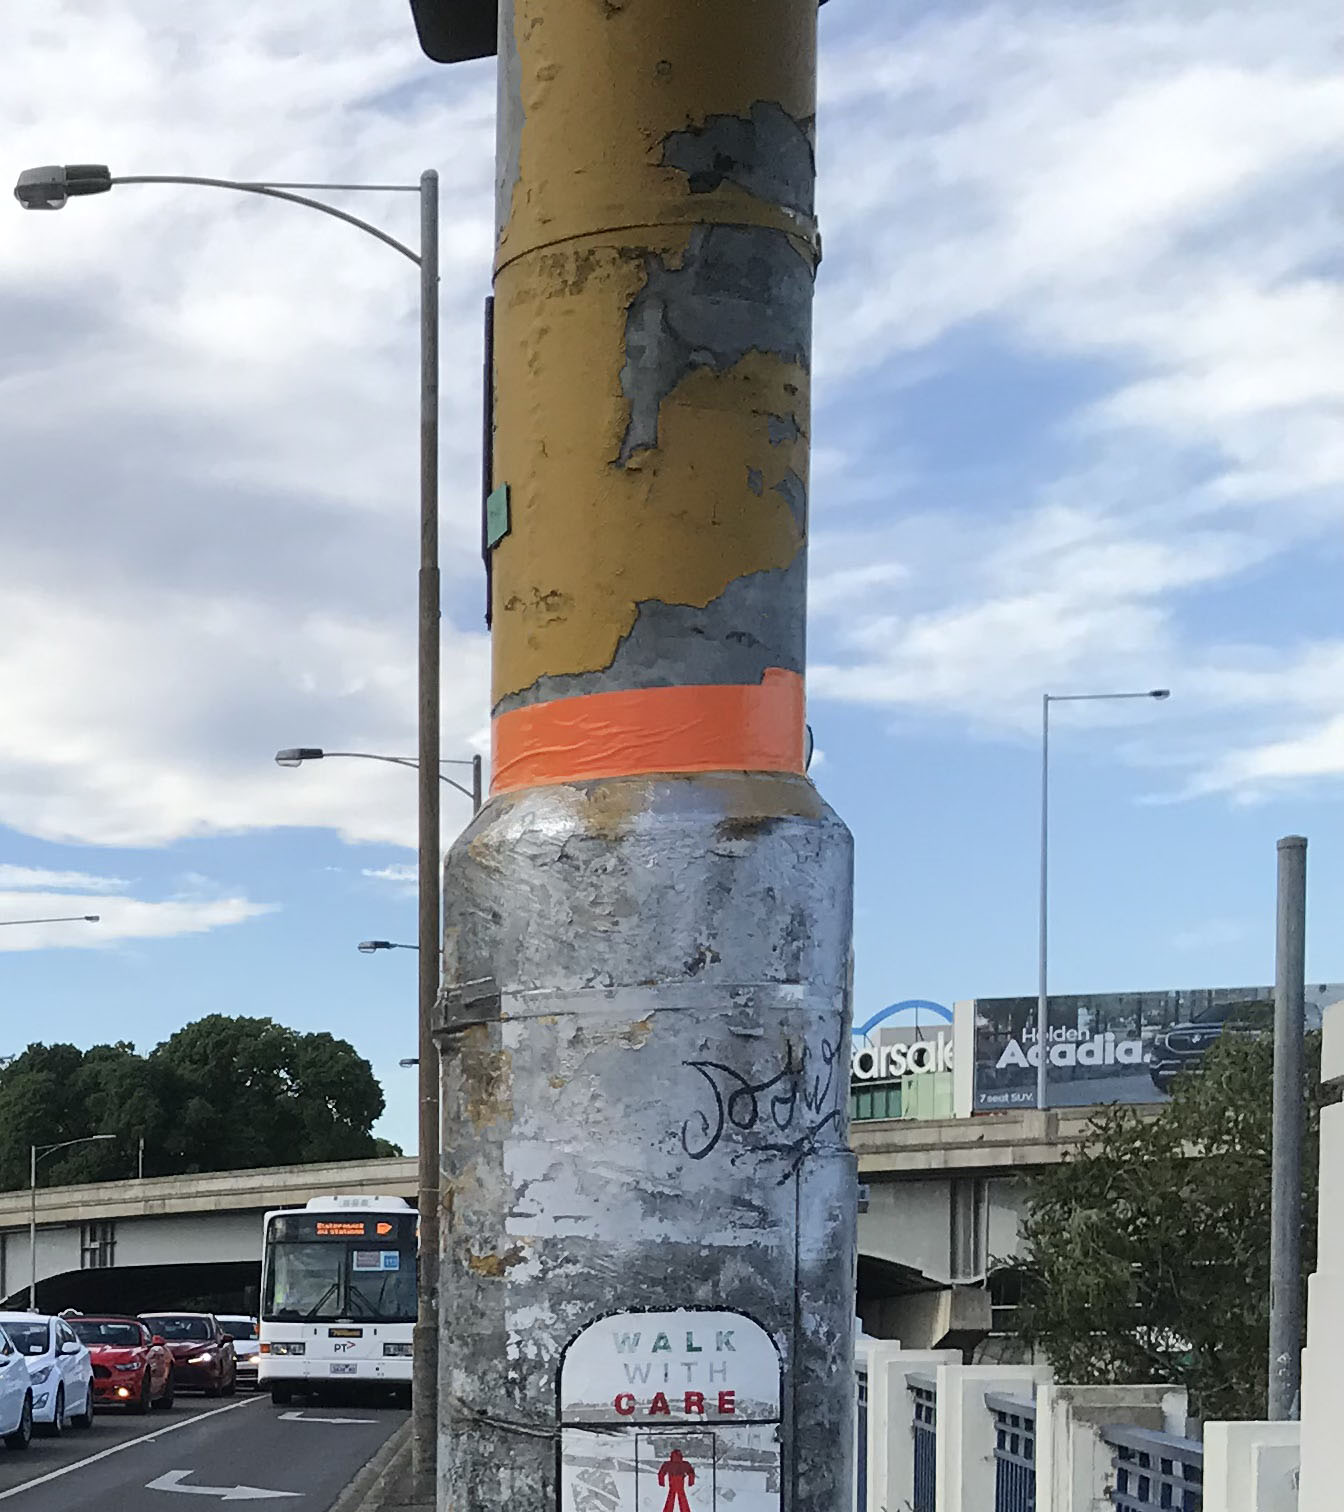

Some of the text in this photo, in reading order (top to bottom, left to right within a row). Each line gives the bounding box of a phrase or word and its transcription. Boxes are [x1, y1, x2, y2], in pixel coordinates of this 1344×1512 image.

[613, 1331, 736, 1354] WALK
[624, 1361, 727, 1384] WITH
[614, 1390, 735, 1416] CARE
